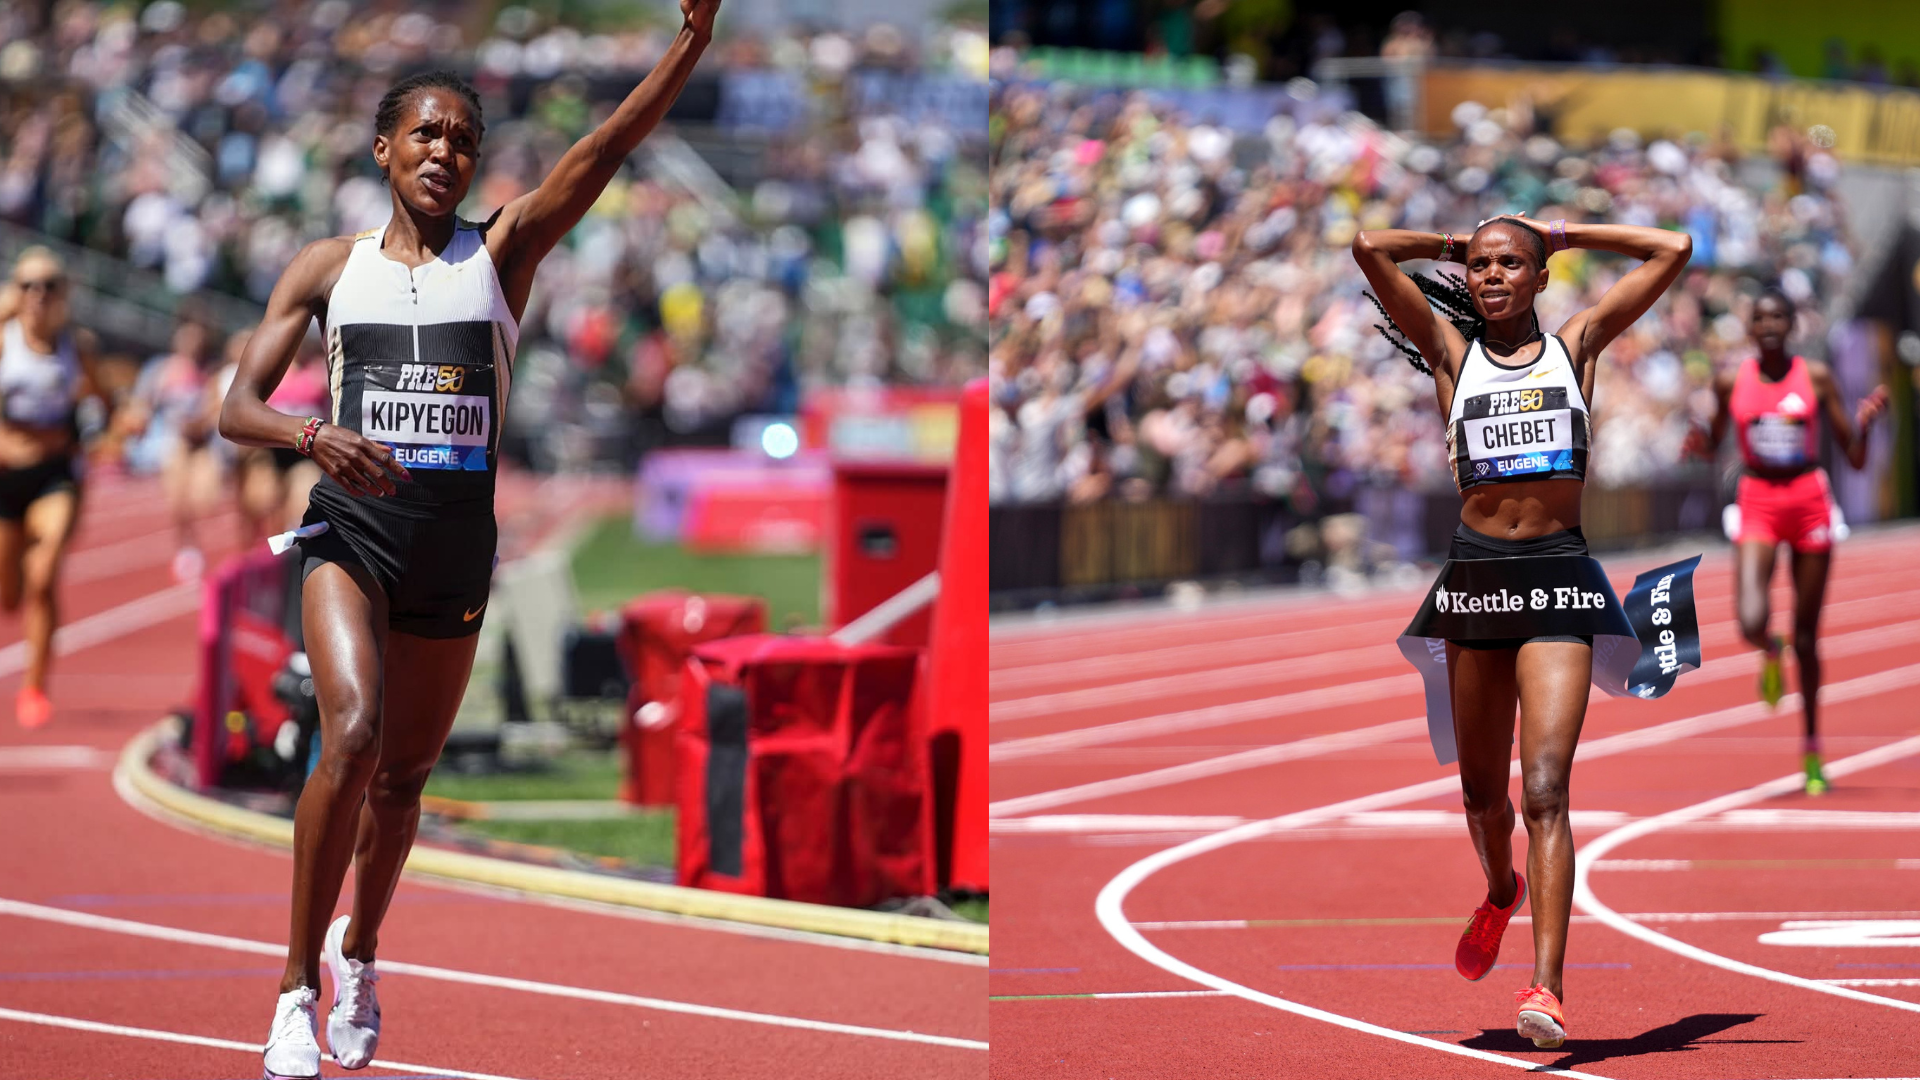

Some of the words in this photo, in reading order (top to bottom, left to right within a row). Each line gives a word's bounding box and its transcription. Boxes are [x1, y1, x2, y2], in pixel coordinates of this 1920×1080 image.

[371, 401, 483, 436] KIPYEGON
[1482, 418, 1556, 450] CHEBET
[395, 448, 459, 465] EUGENE
[1497, 456, 1549, 472] EUGENE
[1450, 588, 1524, 614] Kettle
[1529, 588, 1549, 610] &
[1553, 586, 1606, 610] Fire
[1651, 607, 1672, 626] &
